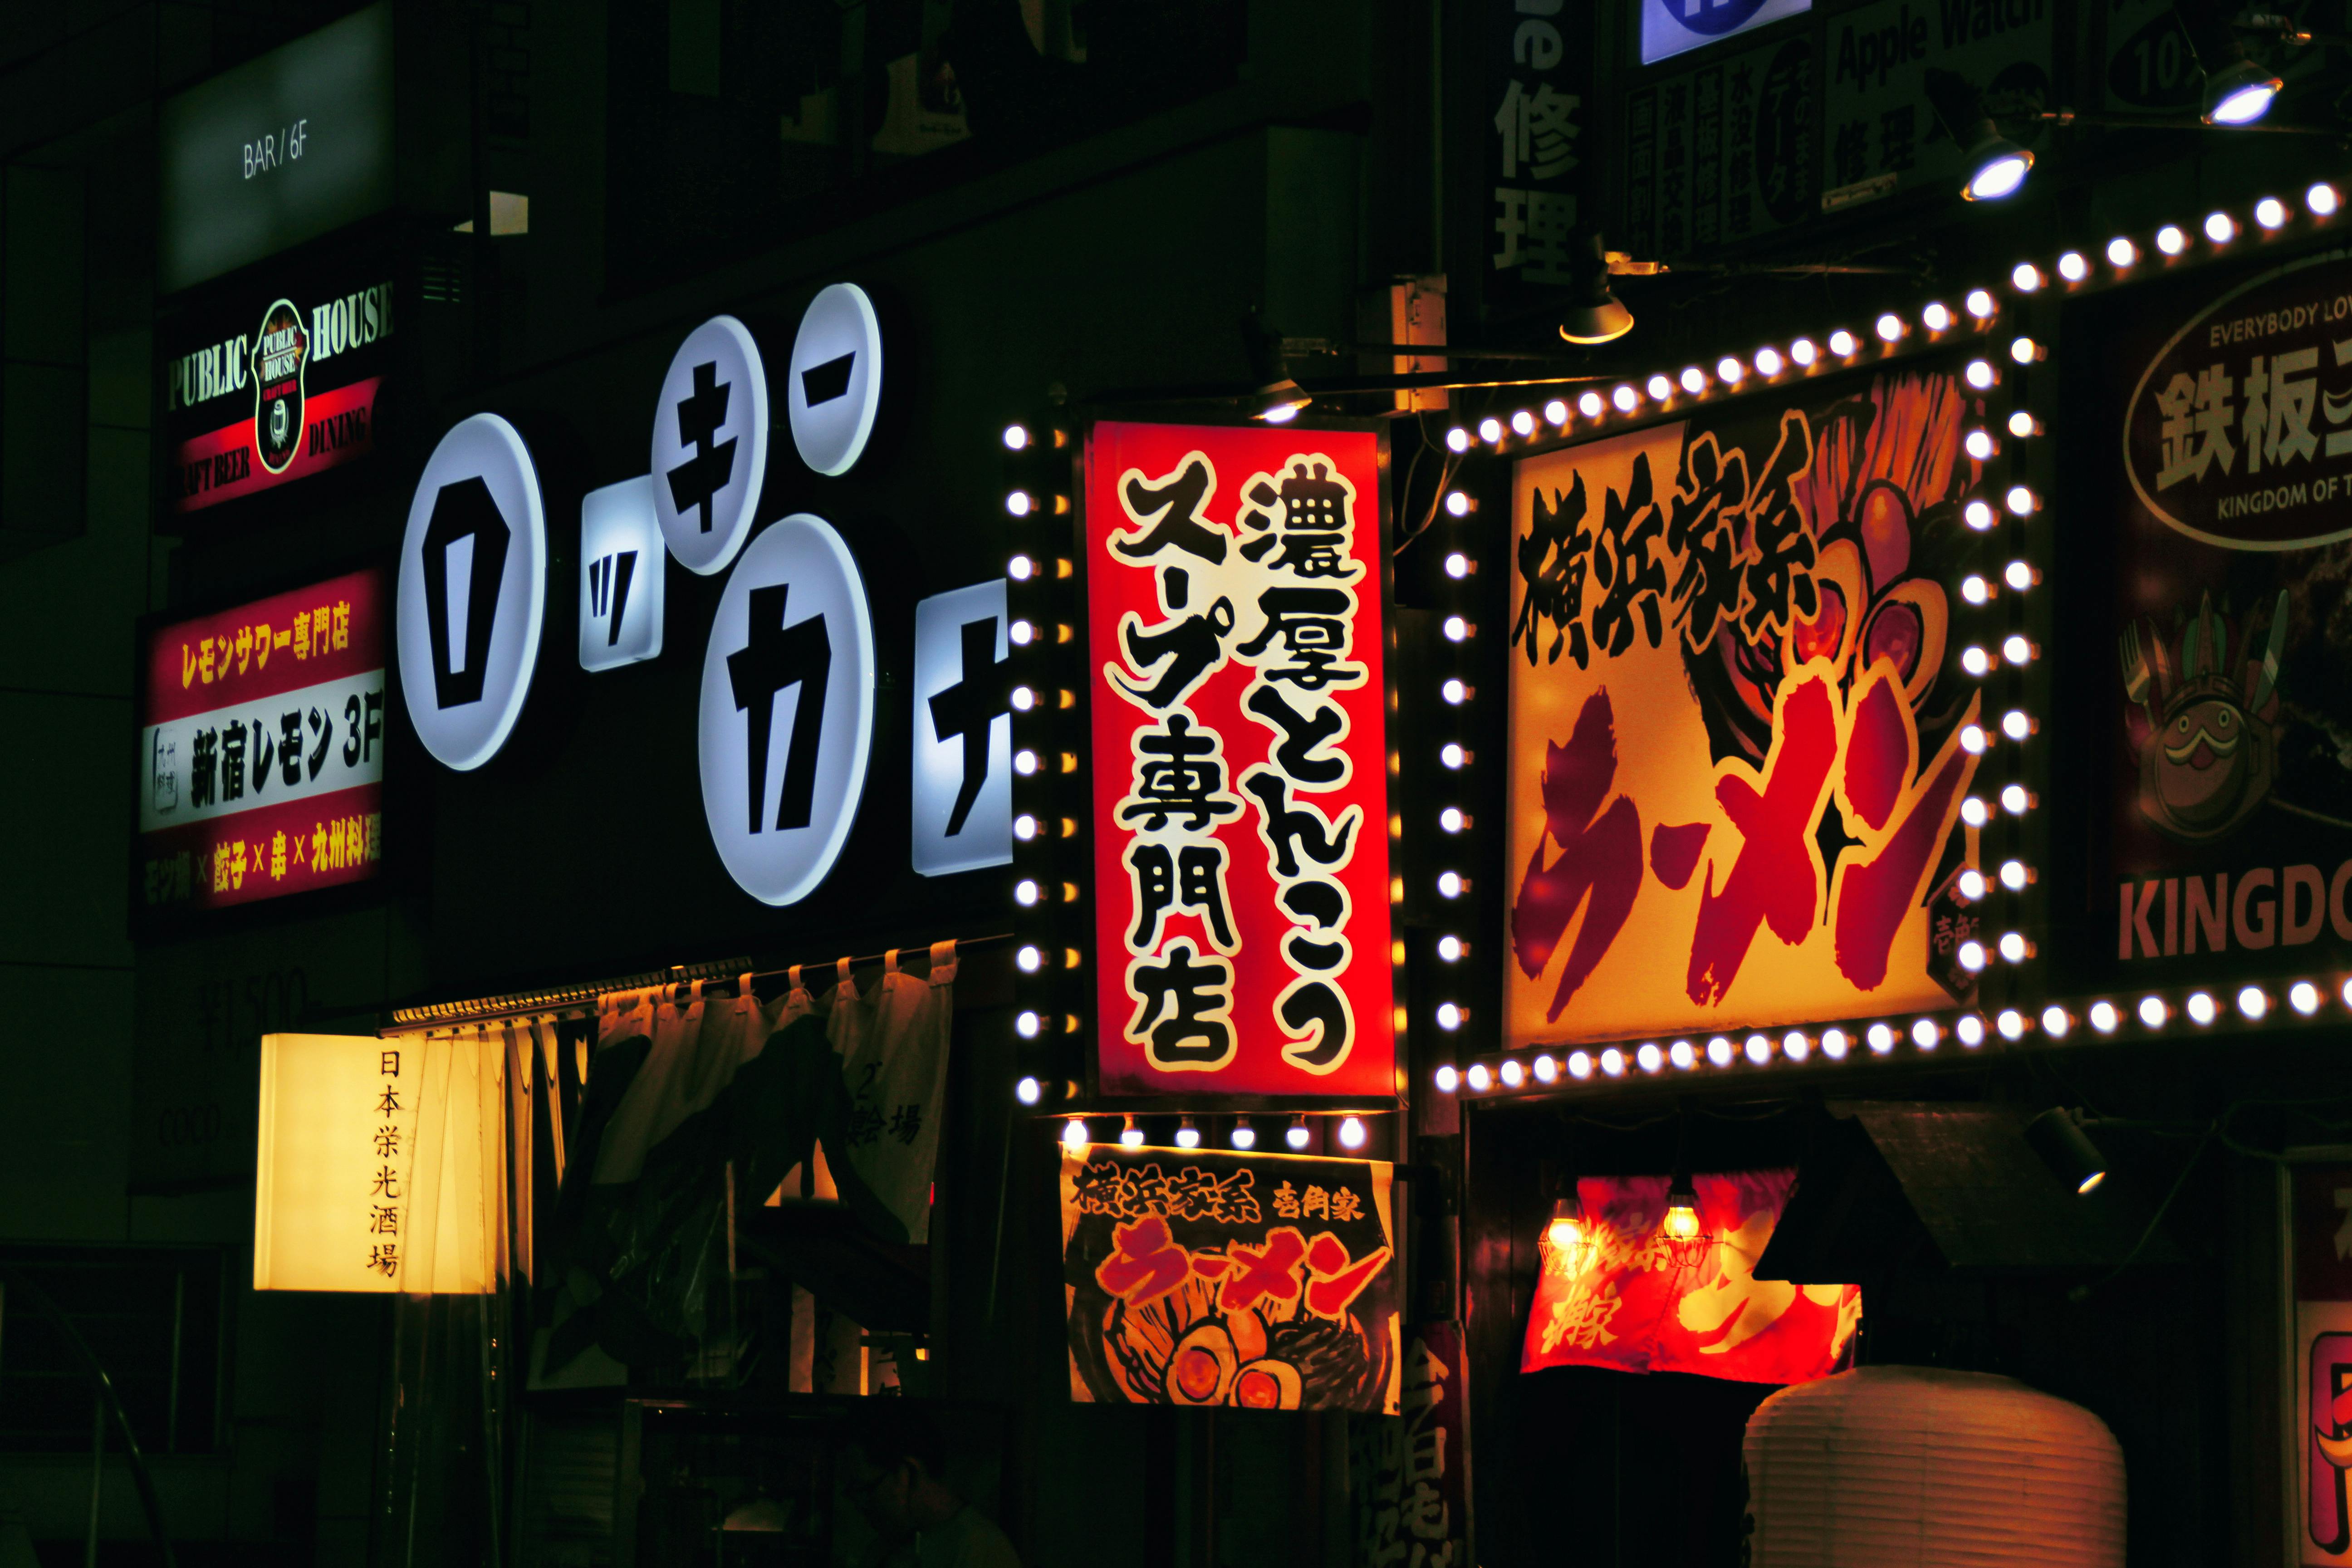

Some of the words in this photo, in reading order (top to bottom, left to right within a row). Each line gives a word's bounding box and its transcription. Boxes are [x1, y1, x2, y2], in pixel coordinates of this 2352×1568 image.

[1836, 5, 1927, 92] Apple
[244, 134, 274, 179] BAR
[289, 119, 308, 160] 6F
[168, 333, 248, 414] PUBLIC
[312, 279, 394, 363] HOUSE
[263, 325, 298, 356] PUBLIC
[265, 352, 296, 382] HOUSE
[2210, 302, 2318, 348] EVERYBODY
[214, 446, 250, 488] BEER
[309, 405, 367, 457] DINING
[1513, 410, 1819, 670] 横浜家系
[2217, 482, 2307, 520] KINGDOM
[2313, 477, 2338, 502] OF
[182, 600, 351, 690] レモンサワー専門店
[191, 706, 333, 808] 新宿レモン
[343, 688, 384, 768] 3F
[1105, 451, 1245, 1071] スープ専門店
[1232, 454, 1367, 1074] 濃厚とんこつ
[270, 829, 287, 882] 串
[311, 810, 382, 874] 九州料理
[1511, 660, 1981, 1024] ラーメン
[365, 1049, 405, 1279] 日本栄光酒場
[1069, 1161, 1261, 1224] 横浜家系
[1272, 1181, 1366, 1221] 壱角家
[1095, 1215, 1392, 1321] ラーメン
